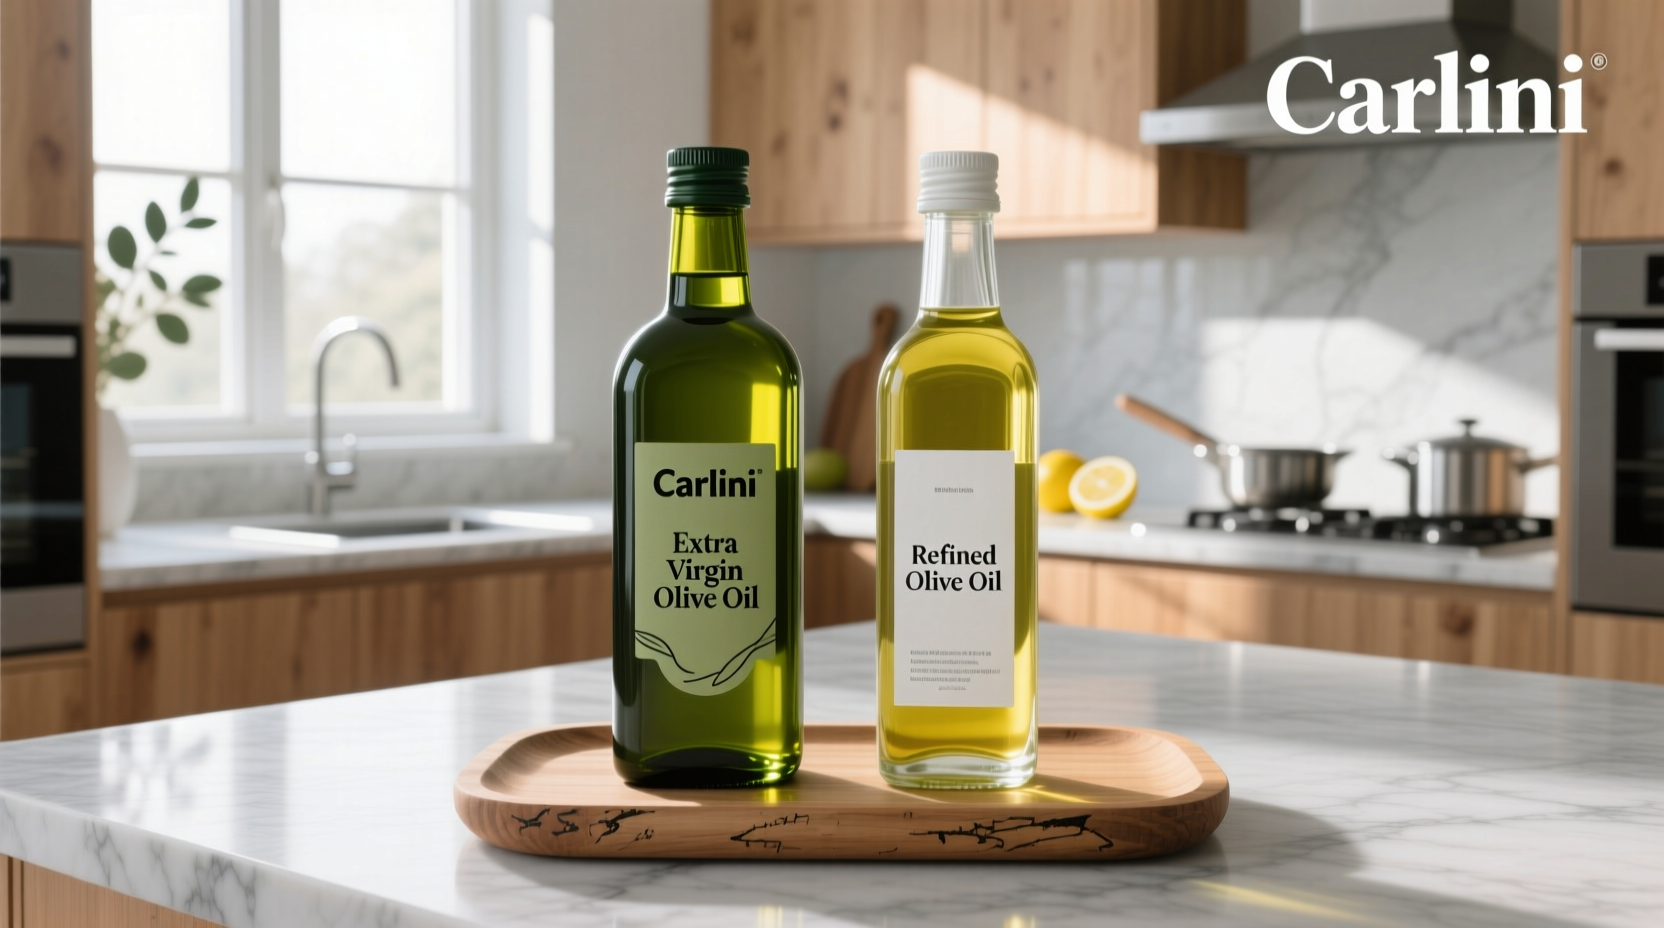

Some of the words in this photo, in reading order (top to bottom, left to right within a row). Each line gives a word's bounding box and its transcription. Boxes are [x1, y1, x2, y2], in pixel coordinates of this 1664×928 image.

[672, 531, 739, 554] Extra
[912, 543, 997, 566] Refined
[666, 558, 744, 588] Virgin
[905, 571, 963, 592] Olive
[969, 570, 1004, 592] Oil
[653, 586, 718, 610] Olive
[722, 585, 760, 610] Oil
